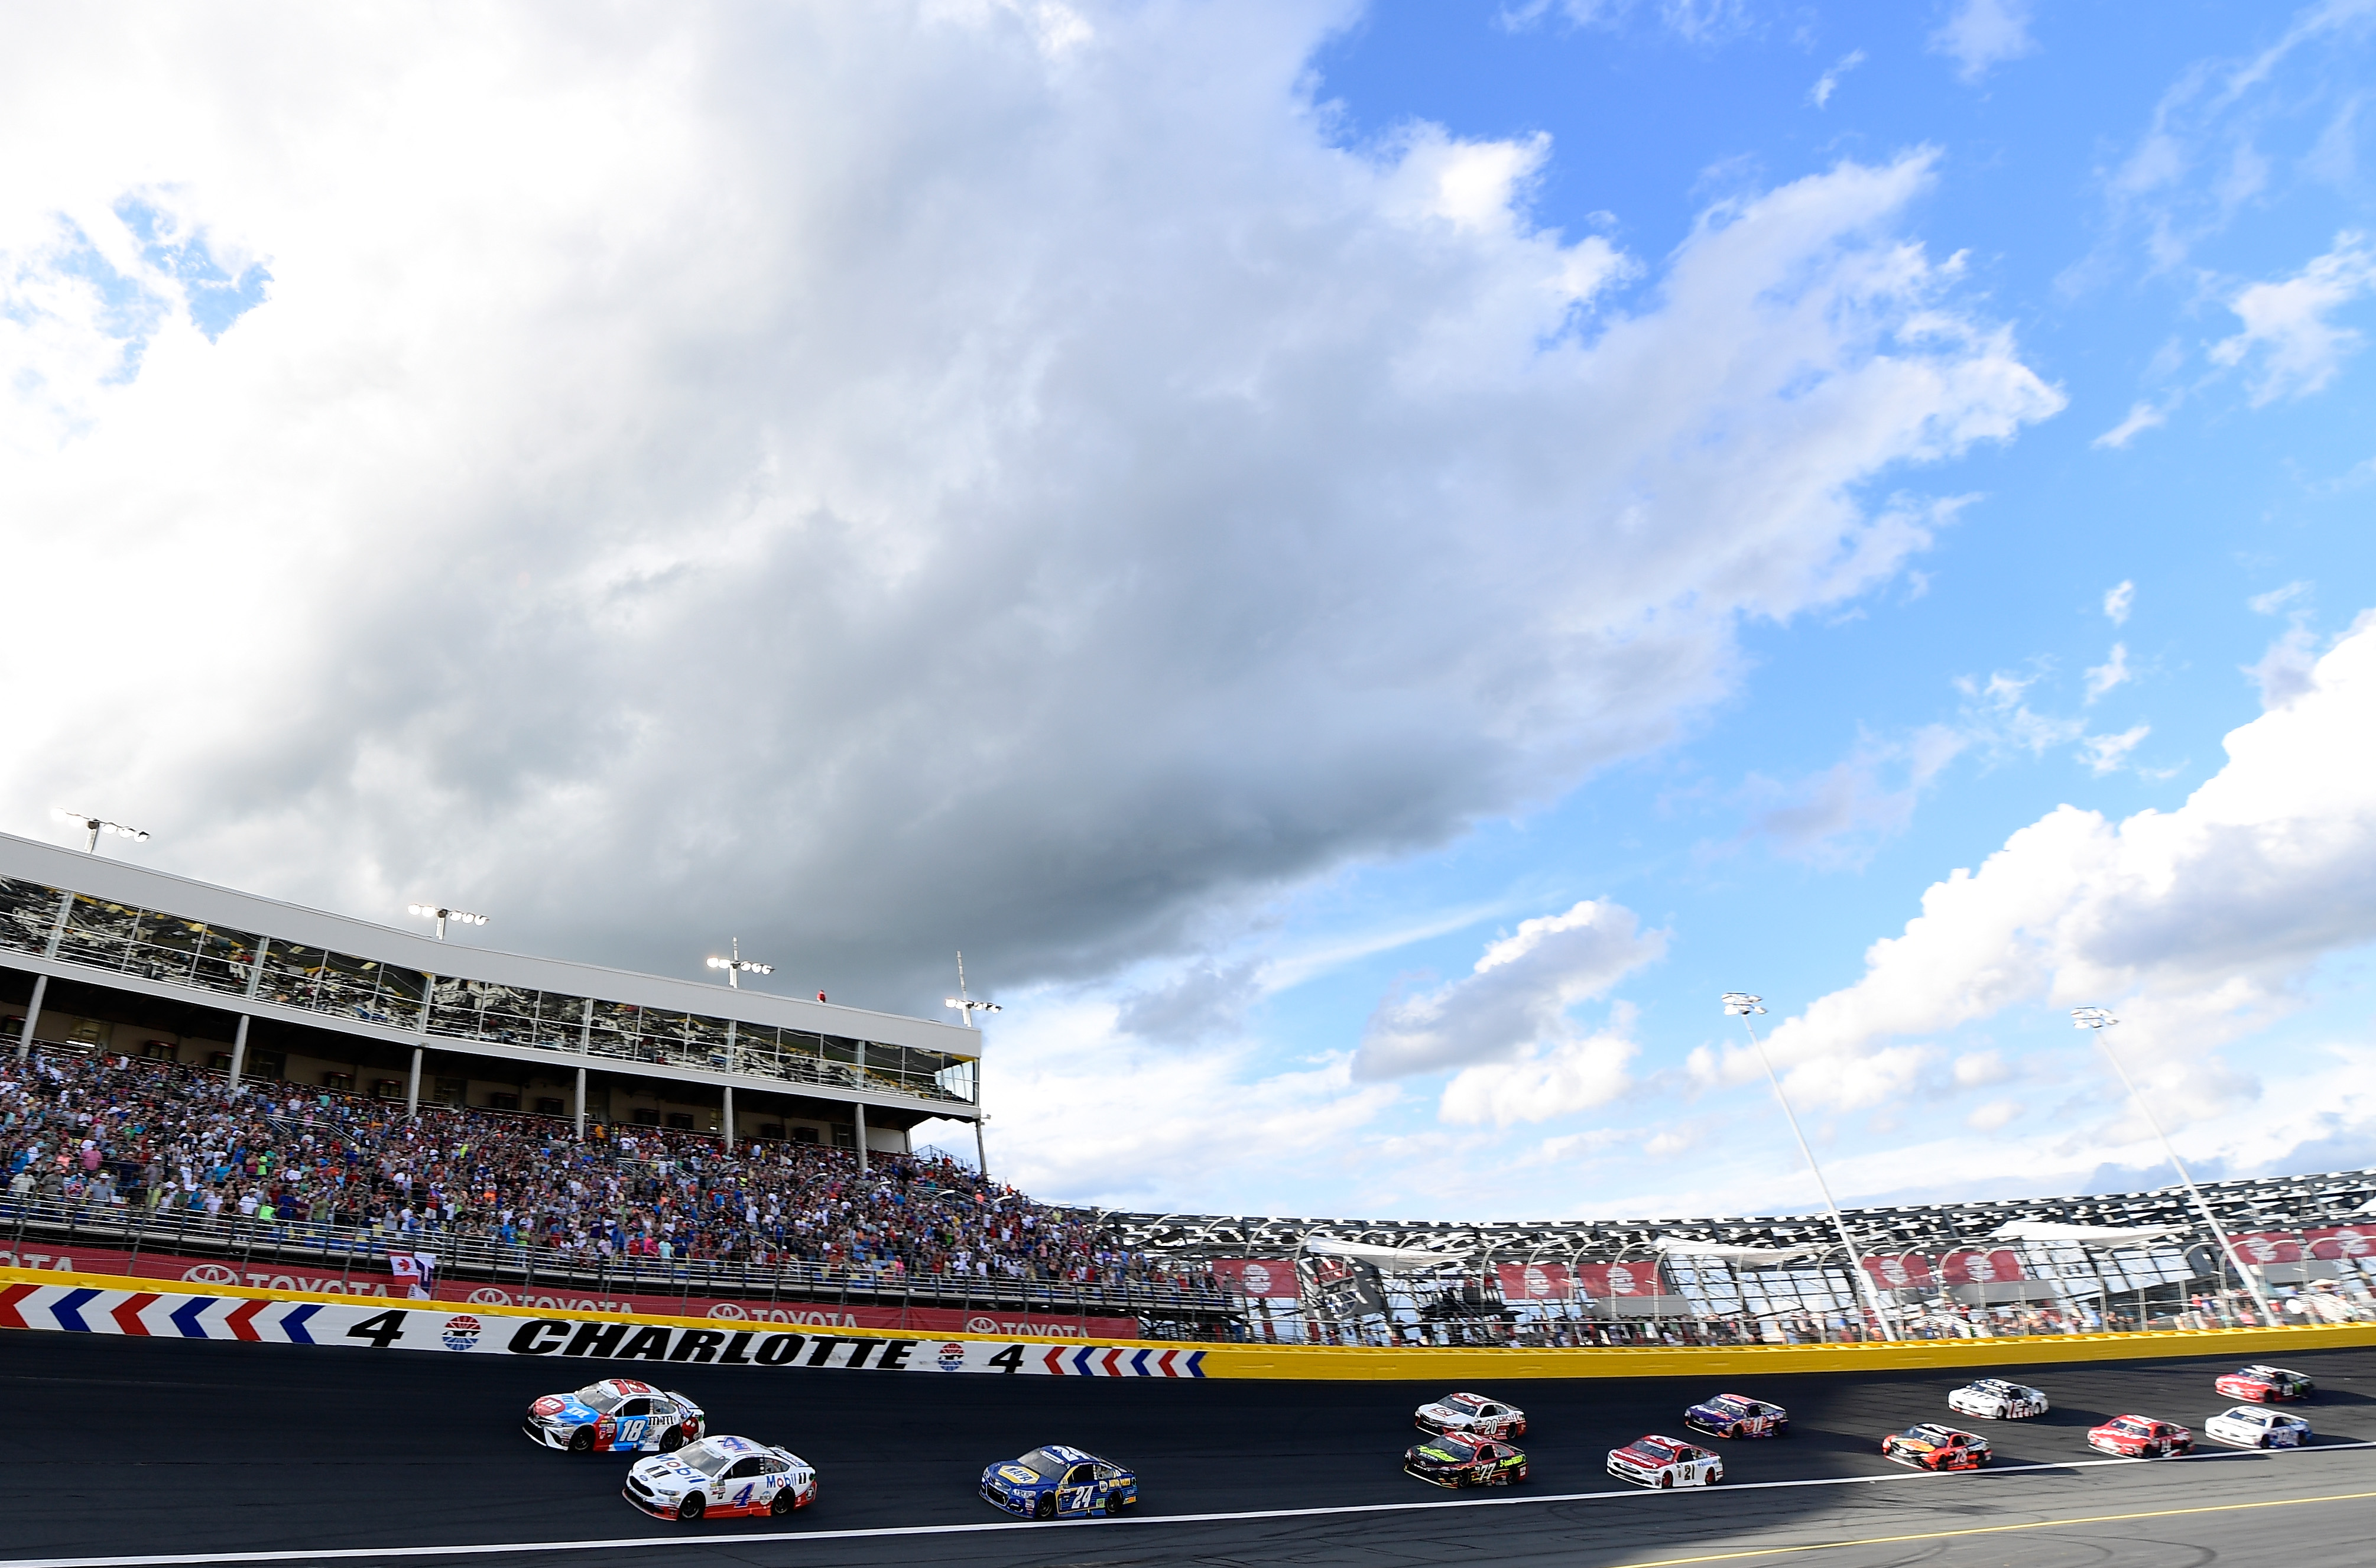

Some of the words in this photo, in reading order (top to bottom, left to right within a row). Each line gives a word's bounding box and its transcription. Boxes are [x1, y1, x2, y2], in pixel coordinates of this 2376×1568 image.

[346, 1310, 408, 1348] 4
[508, 1319, 919, 1370] CHARLOTTE
[989, 1345, 1024, 1374] 4
[618, 1420, 646, 1442] 18
[1484, 1418, 1498, 1435] 20
[721, 1437, 752, 1453] 4
[1052, 1446, 1090, 1462] 24
[1954, 1448, 1969, 1463] 78
[655, 1453, 706, 1484] Mobil
[1005, 1467, 1033, 1482] NAPA
[1480, 1463, 1497, 1481] 77
[1684, 1463, 1695, 1481] 21
[766, 1473, 797, 1488] Mobil
[732, 1482, 755, 1508] 4
[1072, 1486, 1093, 1509] 24
